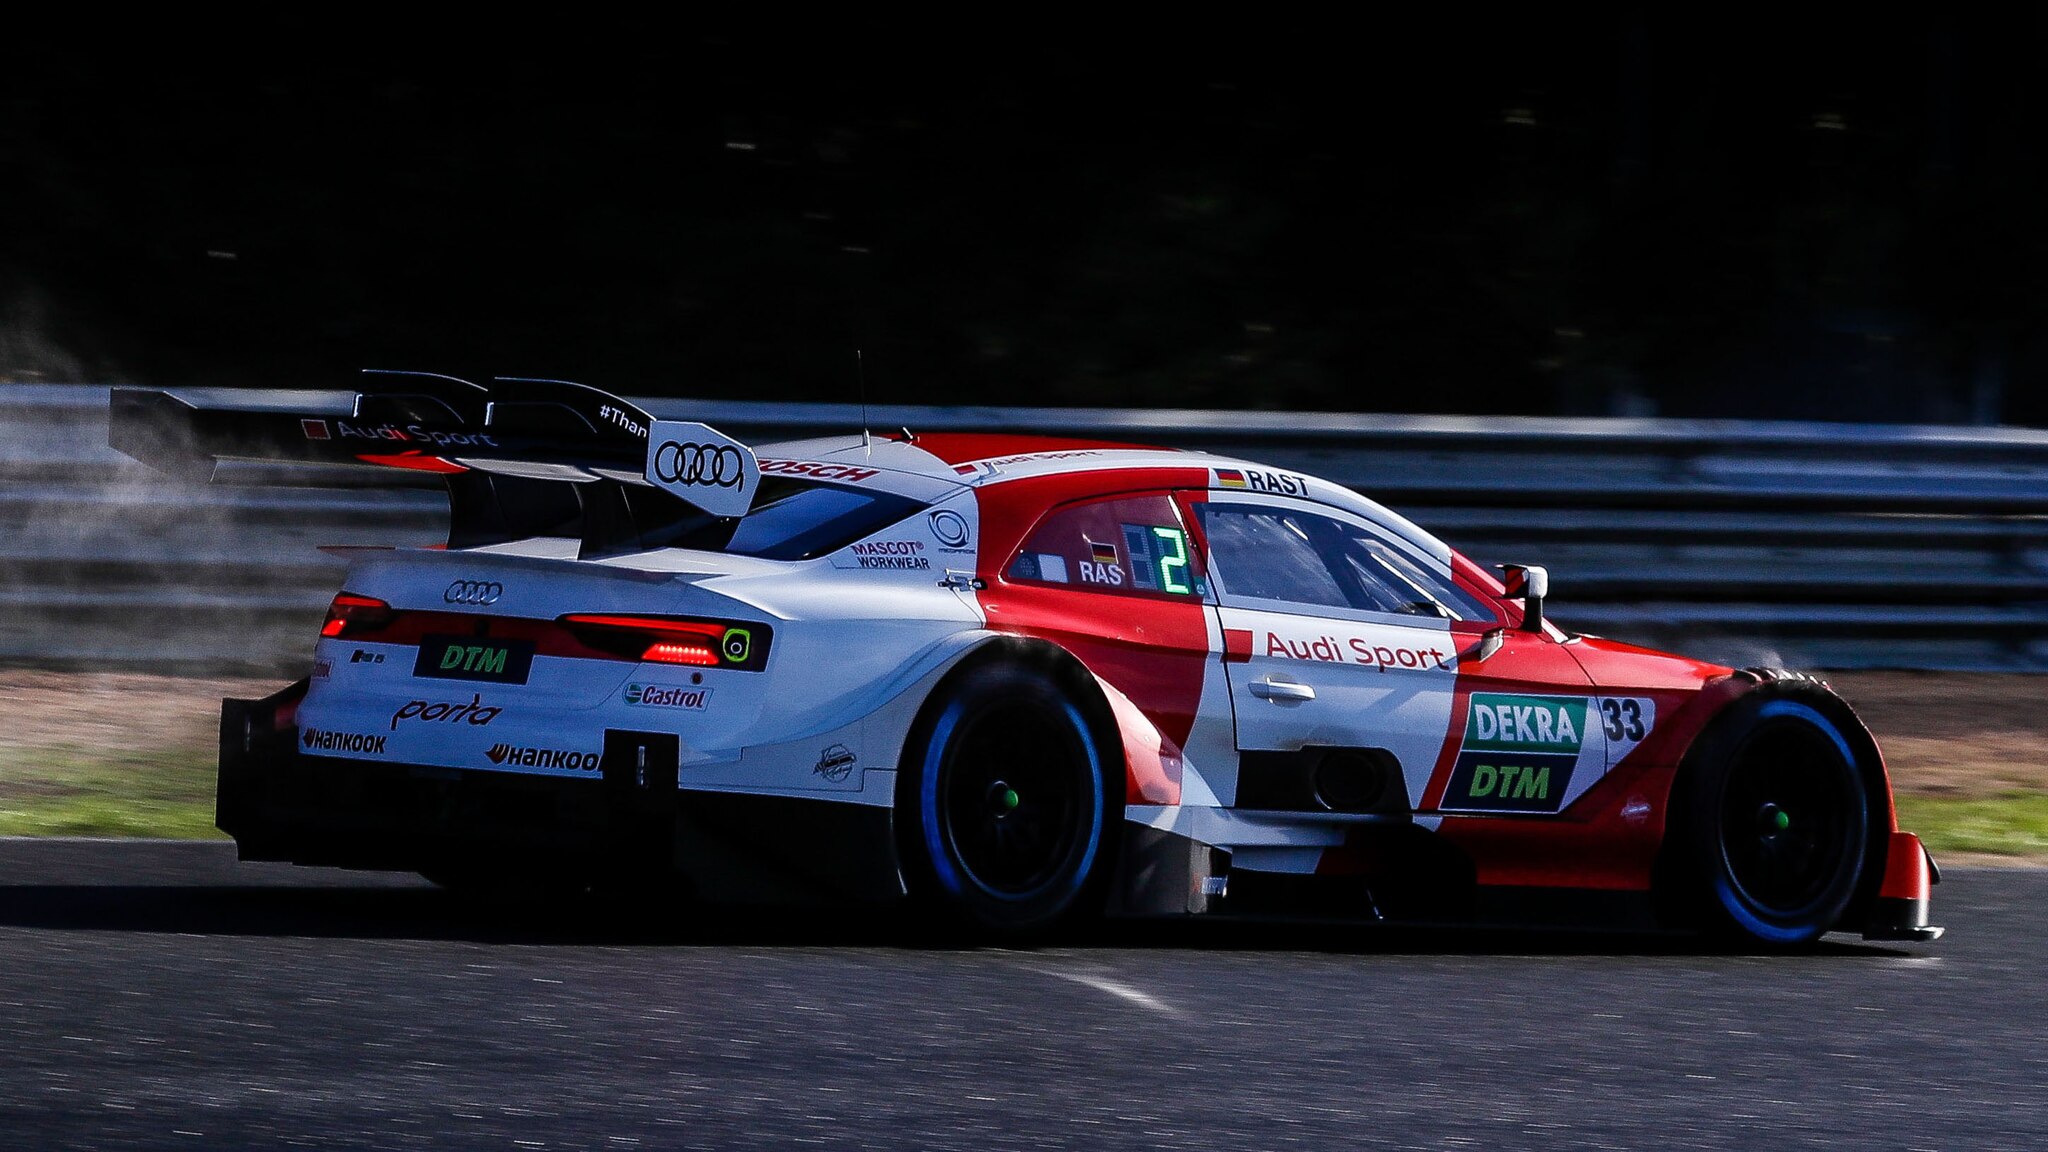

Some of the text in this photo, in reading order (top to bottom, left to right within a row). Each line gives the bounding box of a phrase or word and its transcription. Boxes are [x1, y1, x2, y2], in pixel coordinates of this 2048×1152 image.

[337, 420, 499, 447] Audi Sport
[599, 403, 648, 439] #Than
[1245, 469, 1309, 496] RAST
[856, 556, 931, 569] WORKWEAR
[1078, 560, 1122, 586] RAS
[1152, 526, 1190, 595] 2
[439, 644, 509, 674] DTM
[1266, 631, 1451, 673] Audi Sport
[390, 692, 504, 731] porta
[641, 685, 706, 709] Castrol
[1474, 703, 1579, 744] DEKRA
[1602, 697, 1646, 742] 33
[1468, 764, 1550, 800] DTM
